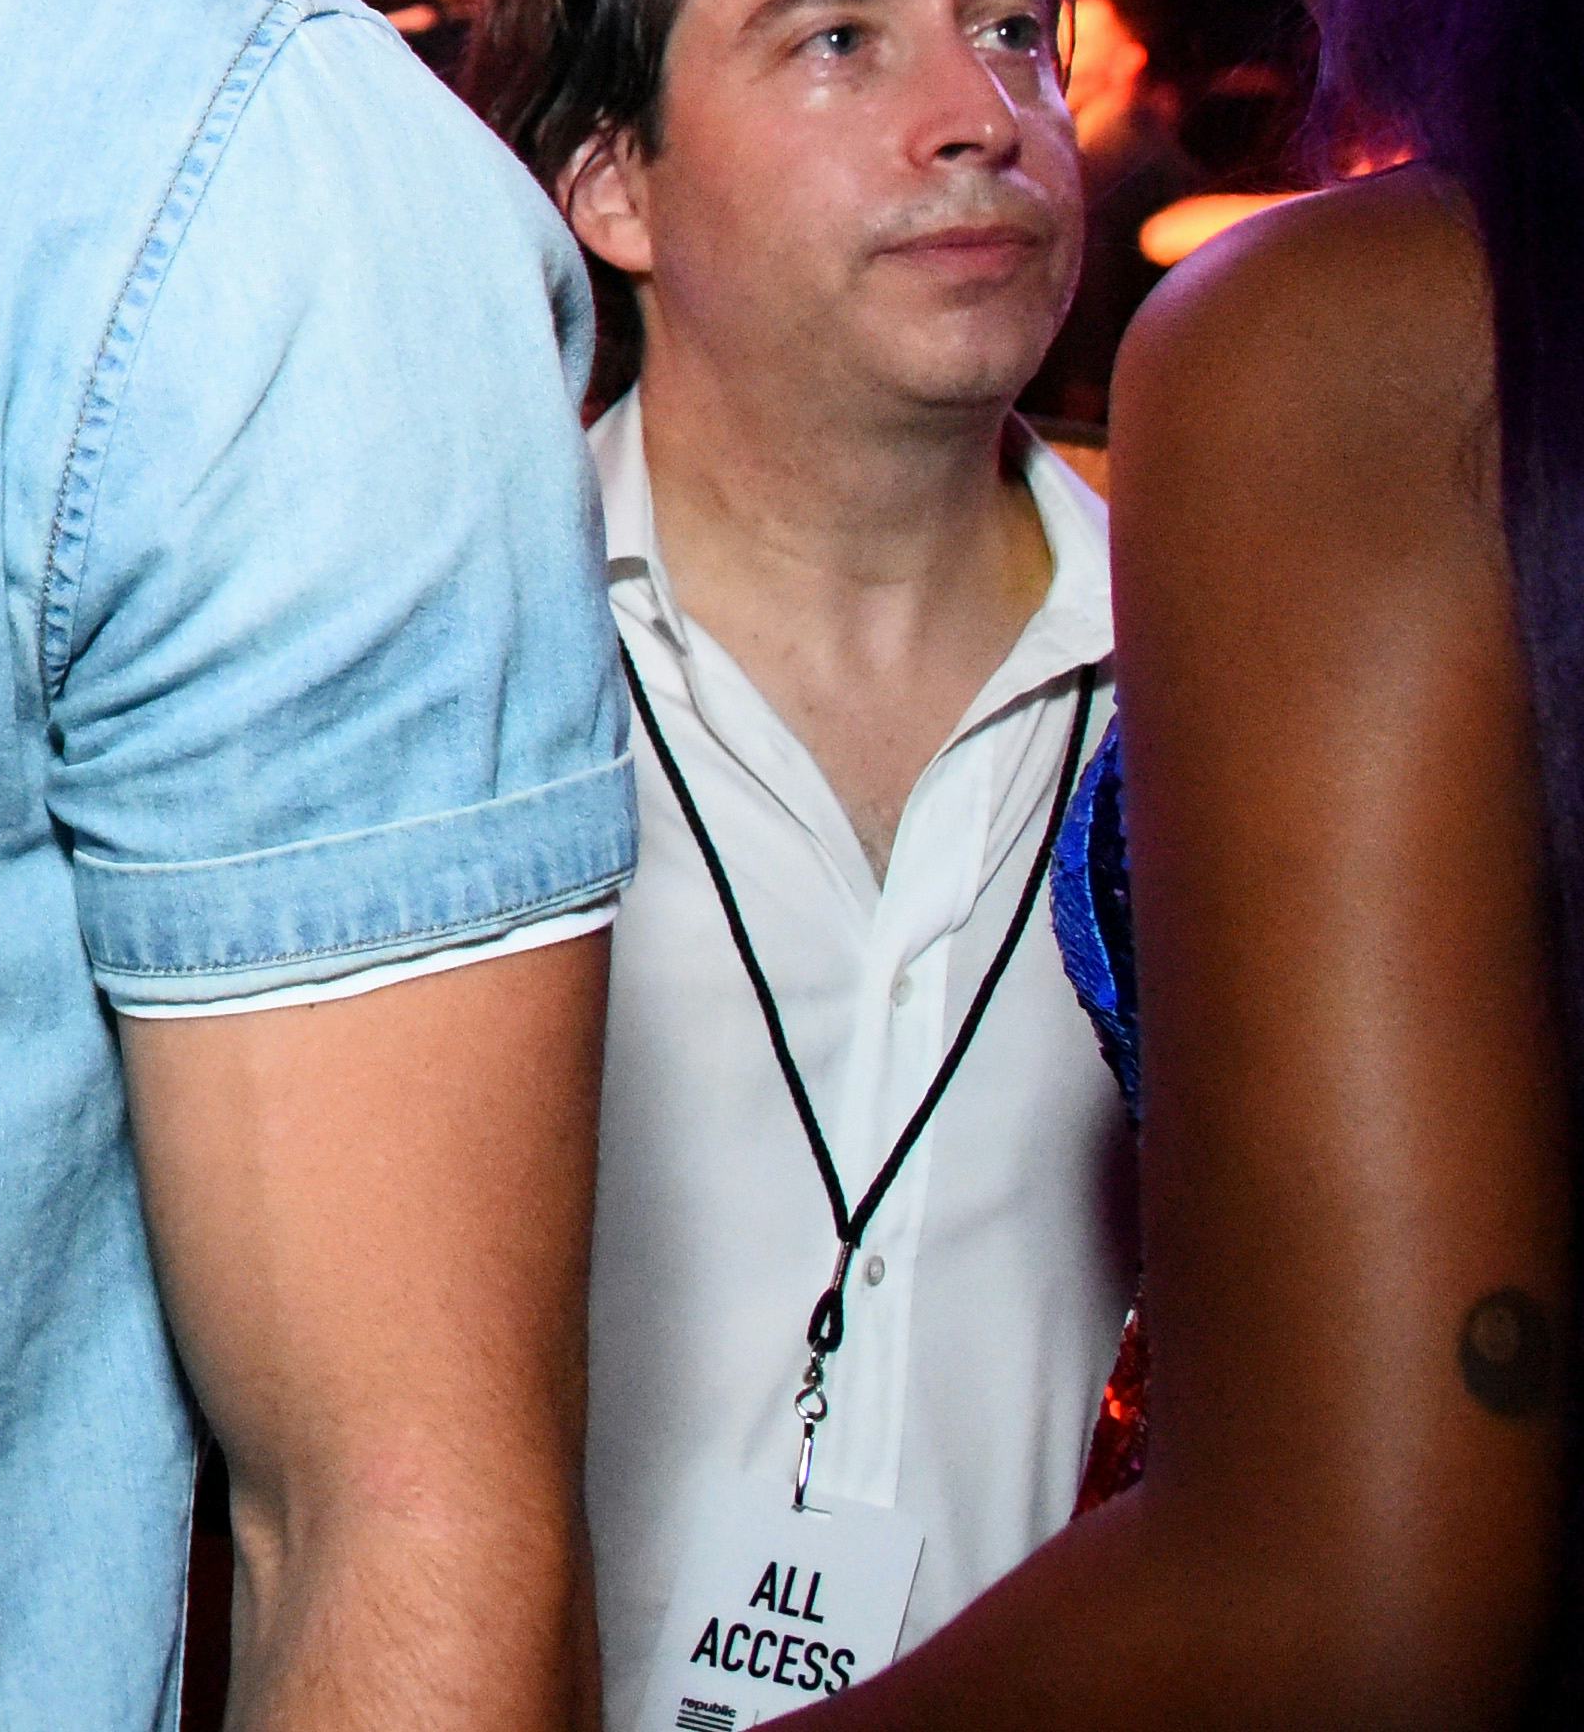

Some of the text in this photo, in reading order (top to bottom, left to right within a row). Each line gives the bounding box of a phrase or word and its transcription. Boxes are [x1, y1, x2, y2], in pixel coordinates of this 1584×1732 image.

[748, 1561, 825, 1624] ALL
[689, 1616, 856, 1698] ACCESS
[680, 1697, 737, 1718] republic
